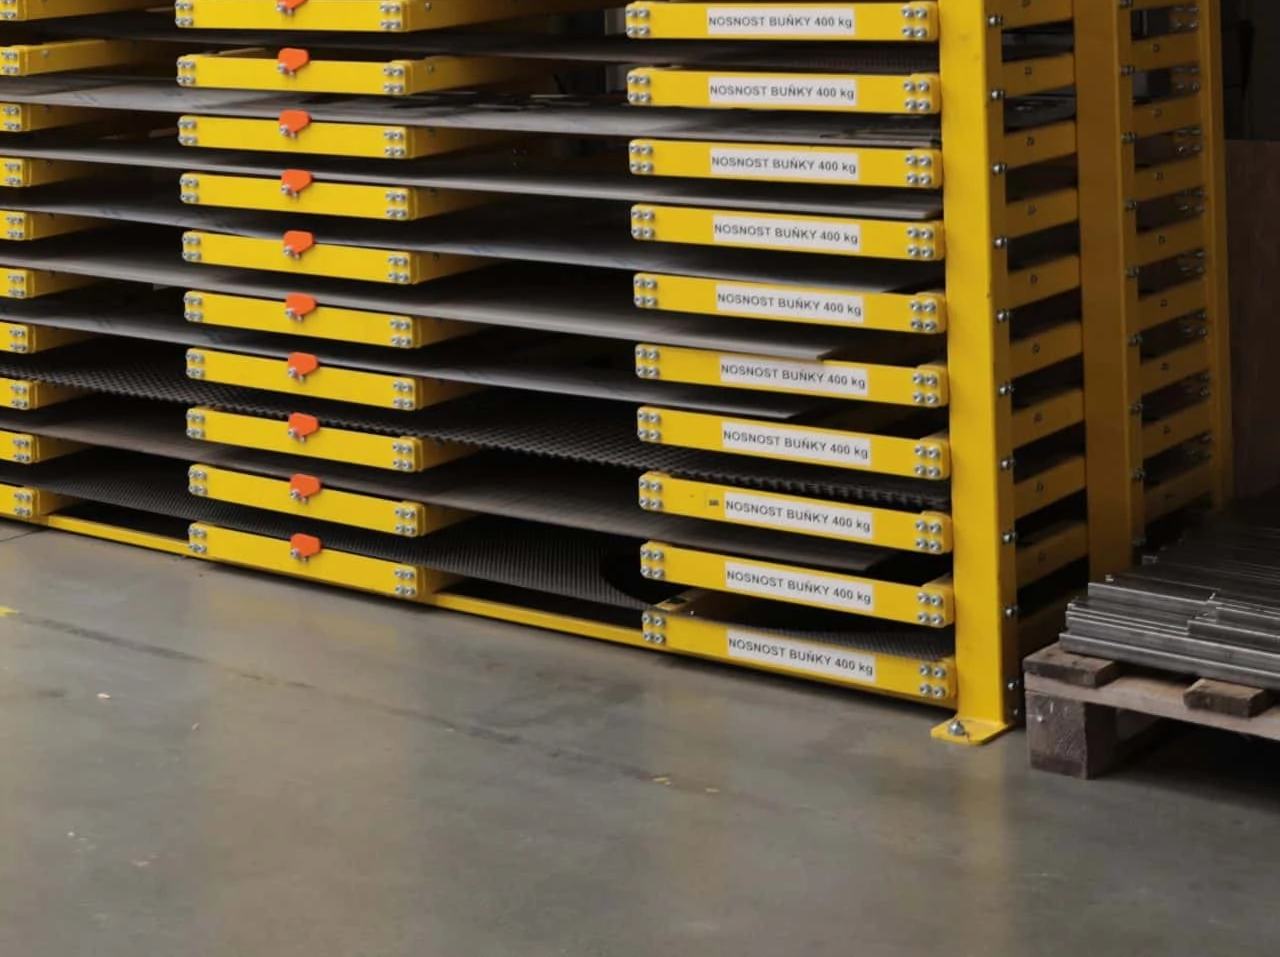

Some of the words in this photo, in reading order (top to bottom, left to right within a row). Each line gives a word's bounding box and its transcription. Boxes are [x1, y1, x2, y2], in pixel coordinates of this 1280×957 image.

[708, 16, 766, 27] NOSNOST
[814, 17, 835, 27] 400
[838, 17, 853, 30] kg
[710, 85, 767, 96] NOSNOST
[816, 88, 837, 98] 400
[840, 88, 854, 101] kg
[712, 156, 769, 169] NOSNOST
[818, 161, 838, 172] 400
[842, 162, 856, 175] kg
[714, 224, 771, 237] NOSNOST
[820, 231, 841, 242] 400
[844, 232, 858, 246] kg
[717, 293, 775, 308] NOSNOST
[823, 302, 844, 314] 400
[847, 304, 862, 318] kg
[721, 363, 778, 379] NOSNOST
[827, 374, 848, 386] 400
[851, 377, 866, 391] kg
[724, 430, 781, 447] NOSNOST
[830, 443, 850, 456] 400
[853, 446, 868, 460] kg
[726, 500, 783, 518] NOSNOST
[832, 515, 852, 528] 400
[856, 519, 870, 533] kg
[727, 570, 784, 589] NOSNOST
[833, 587, 853, 600] 400
[856, 591, 871, 606] kg
[728, 638, 786, 658] NOSNOST
[835, 657, 855, 671] 400
[858, 662, 873, 677] kg
